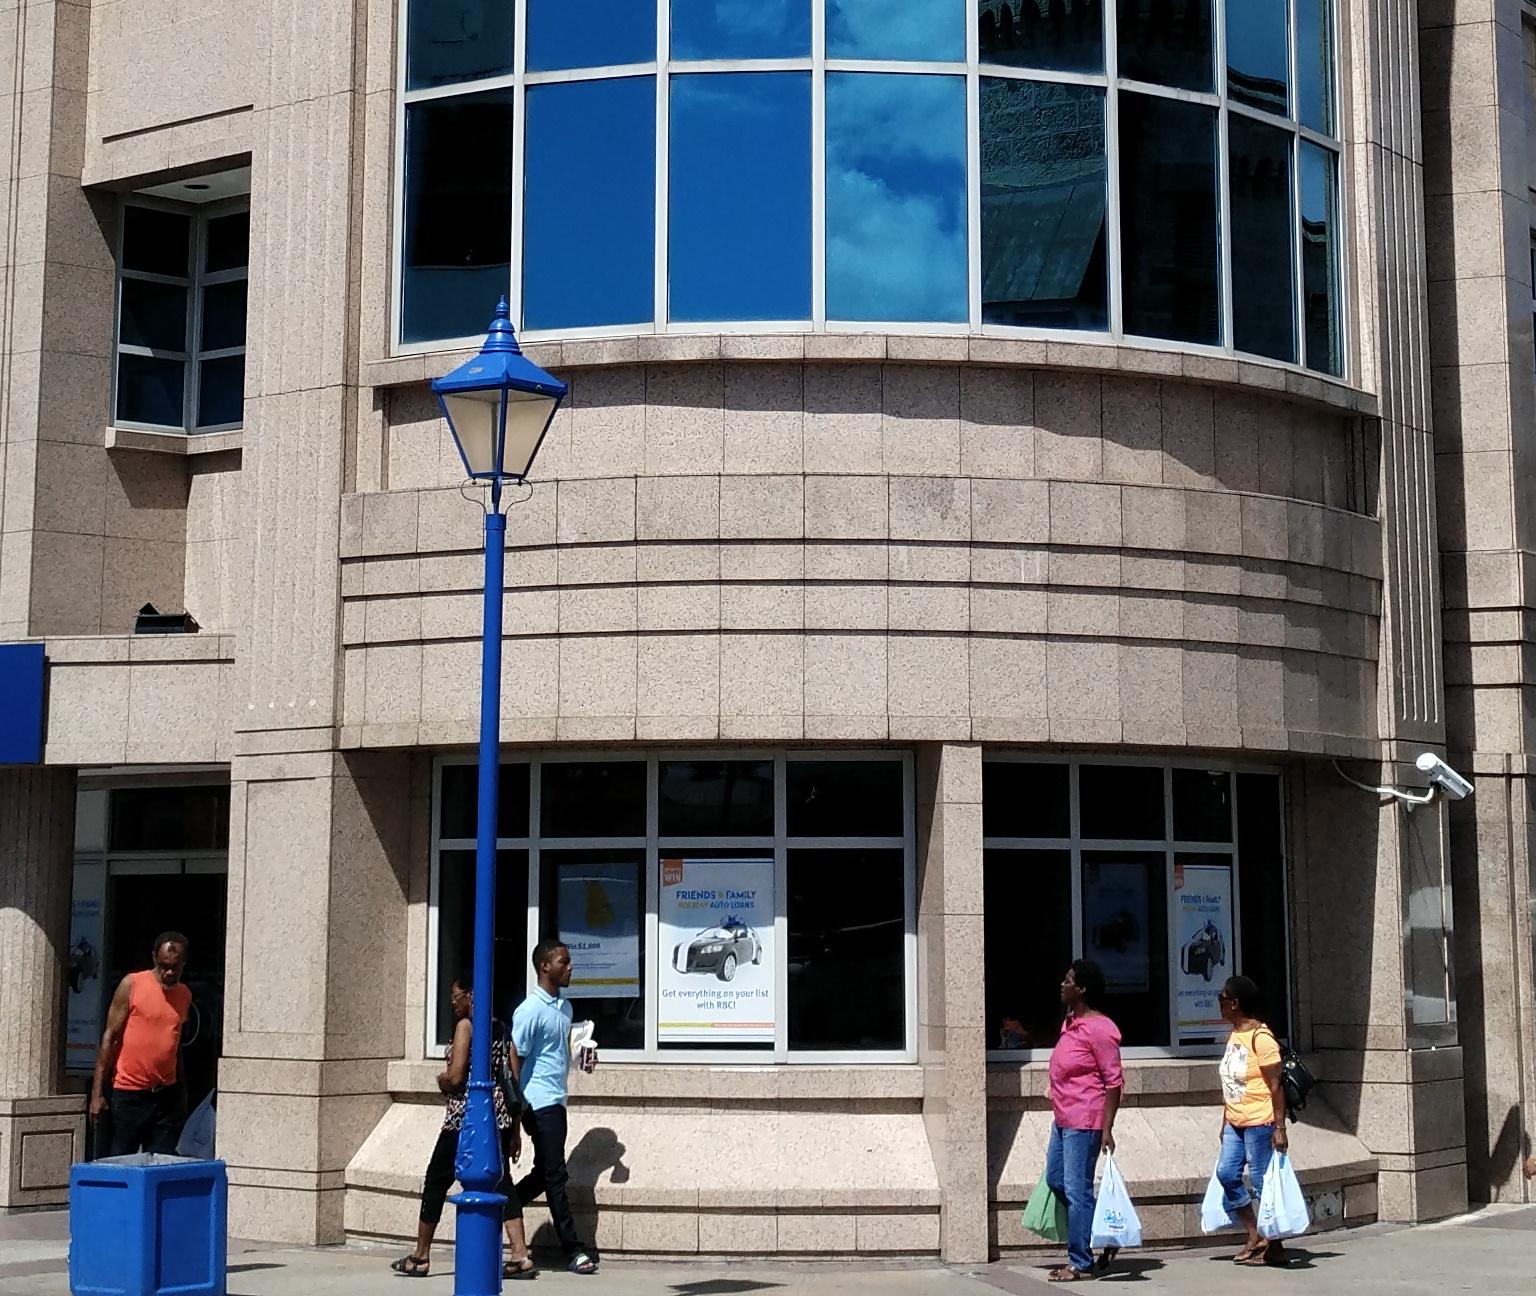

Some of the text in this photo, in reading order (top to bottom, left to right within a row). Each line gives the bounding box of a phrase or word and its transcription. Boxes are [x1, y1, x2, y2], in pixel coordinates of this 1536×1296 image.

[676, 890, 715, 899] FRIENDS
[726, 890, 756, 899] FAMILY
[662, 988, 768, 999] Get everything on your list
[697, 1001, 715, 1009] with
